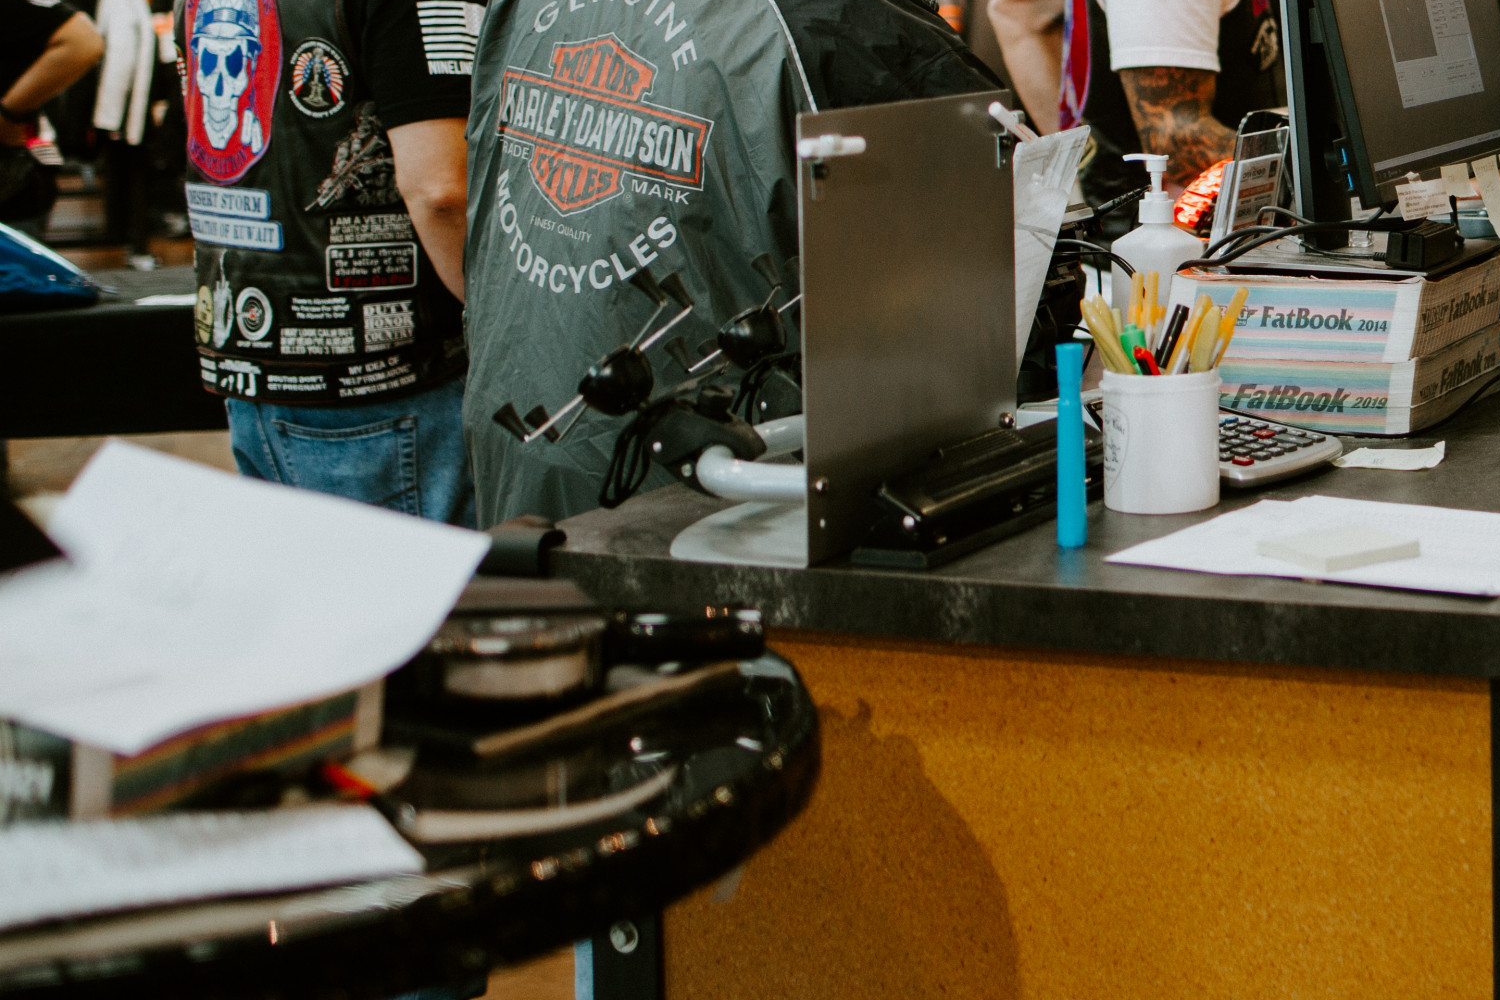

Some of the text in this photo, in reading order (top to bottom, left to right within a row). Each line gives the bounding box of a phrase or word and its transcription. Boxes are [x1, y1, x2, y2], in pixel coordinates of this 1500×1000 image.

[562, 46, 641, 97] MOTOR
[501, 82, 694, 174] HARLEY-DAVIDSON
[536, 151, 613, 204] CYCLES
[631, 179, 690, 205] MARK
[221, 193, 262, 213] STORM
[233, 225, 274, 243] KUWAIT
[497, 168, 678, 294] MOTORCYCLES
[530, 215, 592, 243] FINEST QUALITY
[1260, 306, 1354, 331] FatBook
[1357, 319, 1388, 332] 2014
[1231, 383, 1388, 413] FatBook 2019
